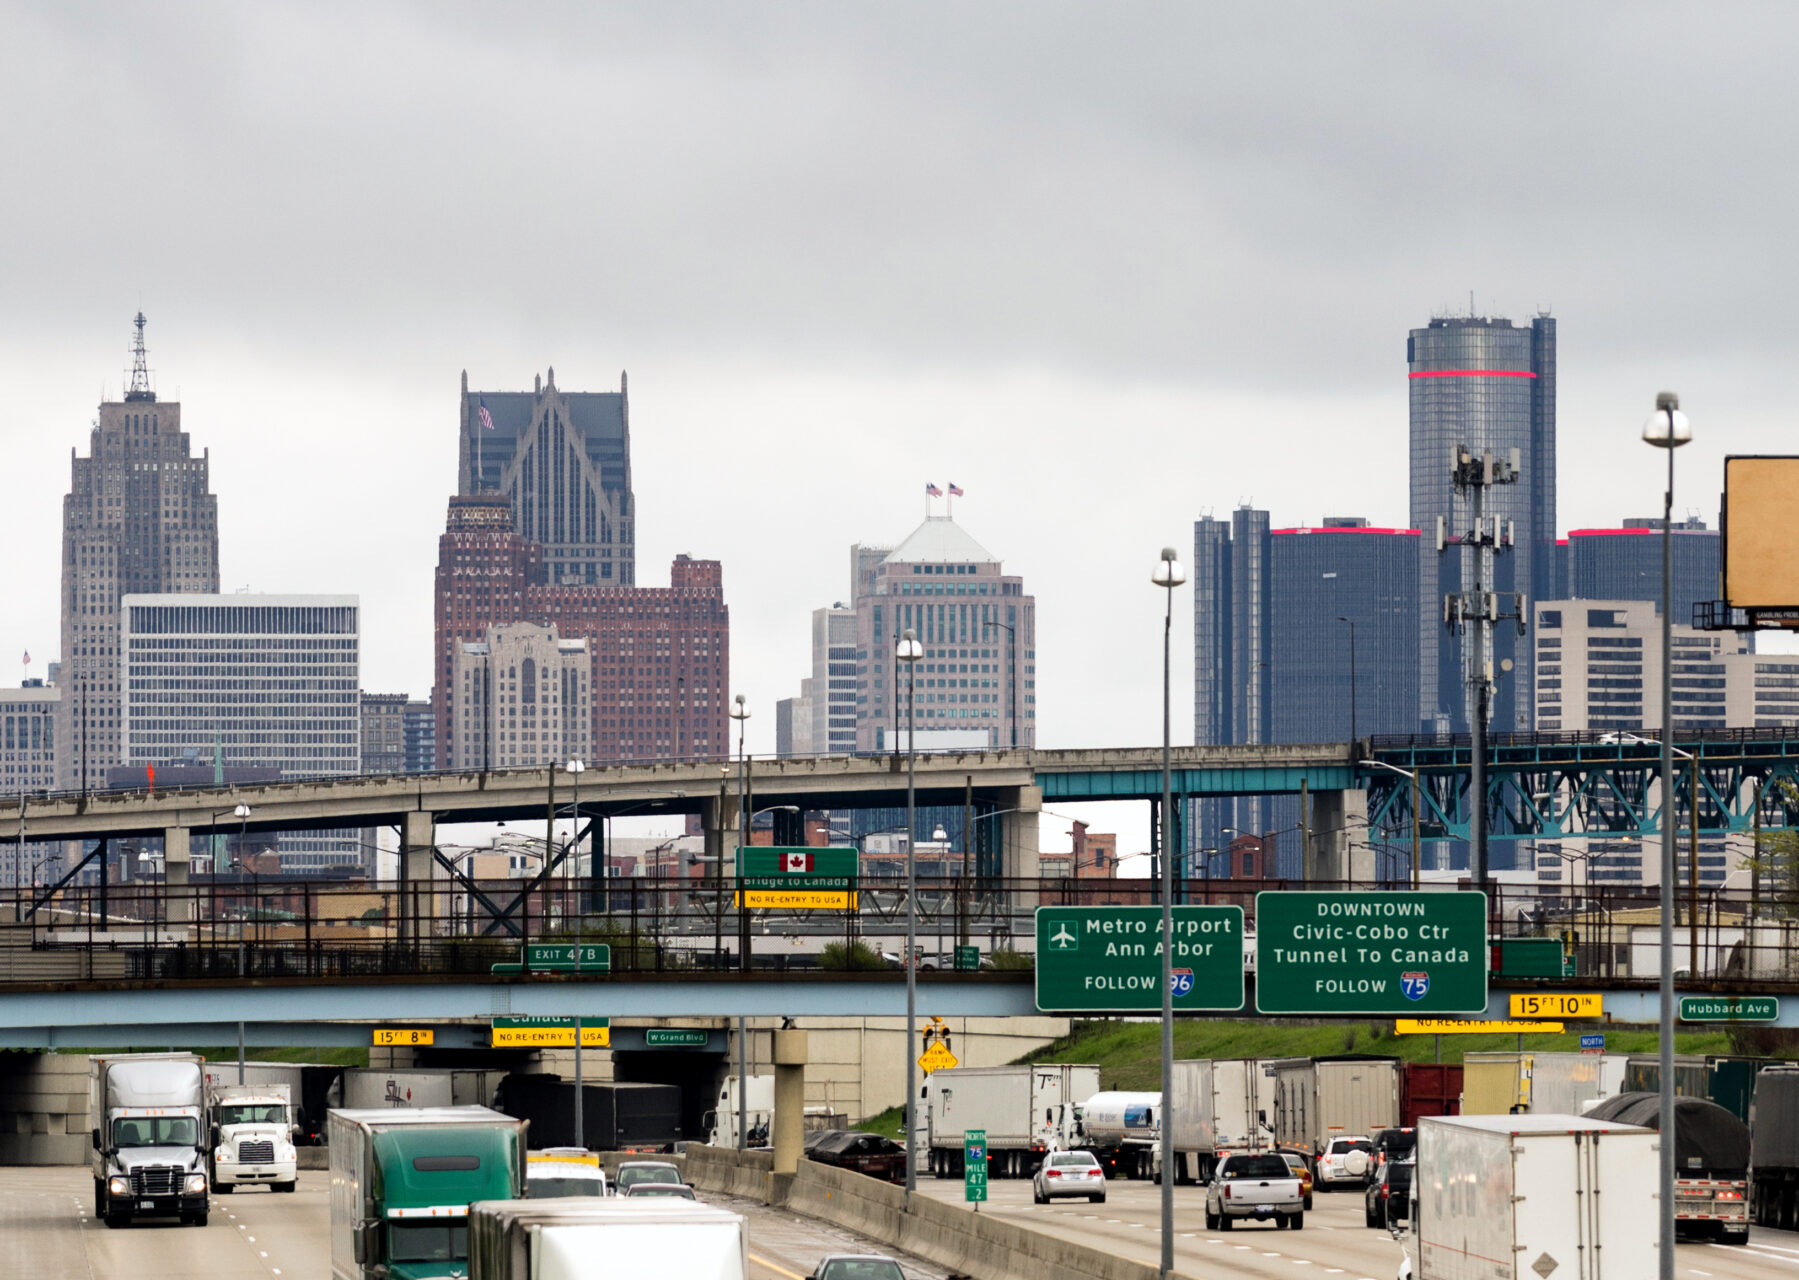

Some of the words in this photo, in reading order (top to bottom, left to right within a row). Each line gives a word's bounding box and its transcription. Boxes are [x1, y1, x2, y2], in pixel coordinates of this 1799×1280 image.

[744, 876, 784, 888] Bridge
[788, 877, 800, 886] to
[804, 876, 849, 886] Canada
[824, 896, 841, 904] USA
[1317, 903, 1425, 917] DOWNTOWN
[1086, 919, 1147, 934] Metro
[1155, 917, 1232, 937] Airport
[1293, 924, 1409, 940] Civic-Cobo
[1419, 925, 1450, 940] Ctr
[535, 949, 561, 960] EXIT
[567, 949, 584, 960] 47
[587, 949, 596, 960] B
[1105, 942, 1145, 957] Ann
[1273, 948, 1347, 963] Tunnel
[1357, 948, 1382, 963] To
[1391, 947, 1469, 963] Canada
[1085, 976, 1156, 990] FOLLOW
[1171, 975, 1190, 991] 96
[1315, 979, 1387, 993] FOLLOW
[1402, 978, 1428, 995] 75
[1520, 997, 1540, 1014] 15
[1542, 997, 1555, 1006] FT
[1560, 997, 1579, 1014] 10
[1581, 997, 1592, 1006] IN
[1688, 1004, 1743, 1013] Hubbard
[1747, 1004, 1770, 1013] Ave
[380, 1032, 393, 1043] 15
[411, 1031, 419, 1043] 8
[500, 1033, 512, 1041] NO
[516, 1033, 563, 1041] RE-ENTRY
[583, 1033, 603, 1041] USA
[1582, 1037, 1604, 1046] NORTH
[965, 1132, 987, 1140] NORTH
[970, 1147, 982, 1157] 75
[966, 1164, 986, 1173] MILE
[969, 1173, 983, 1184] 47
